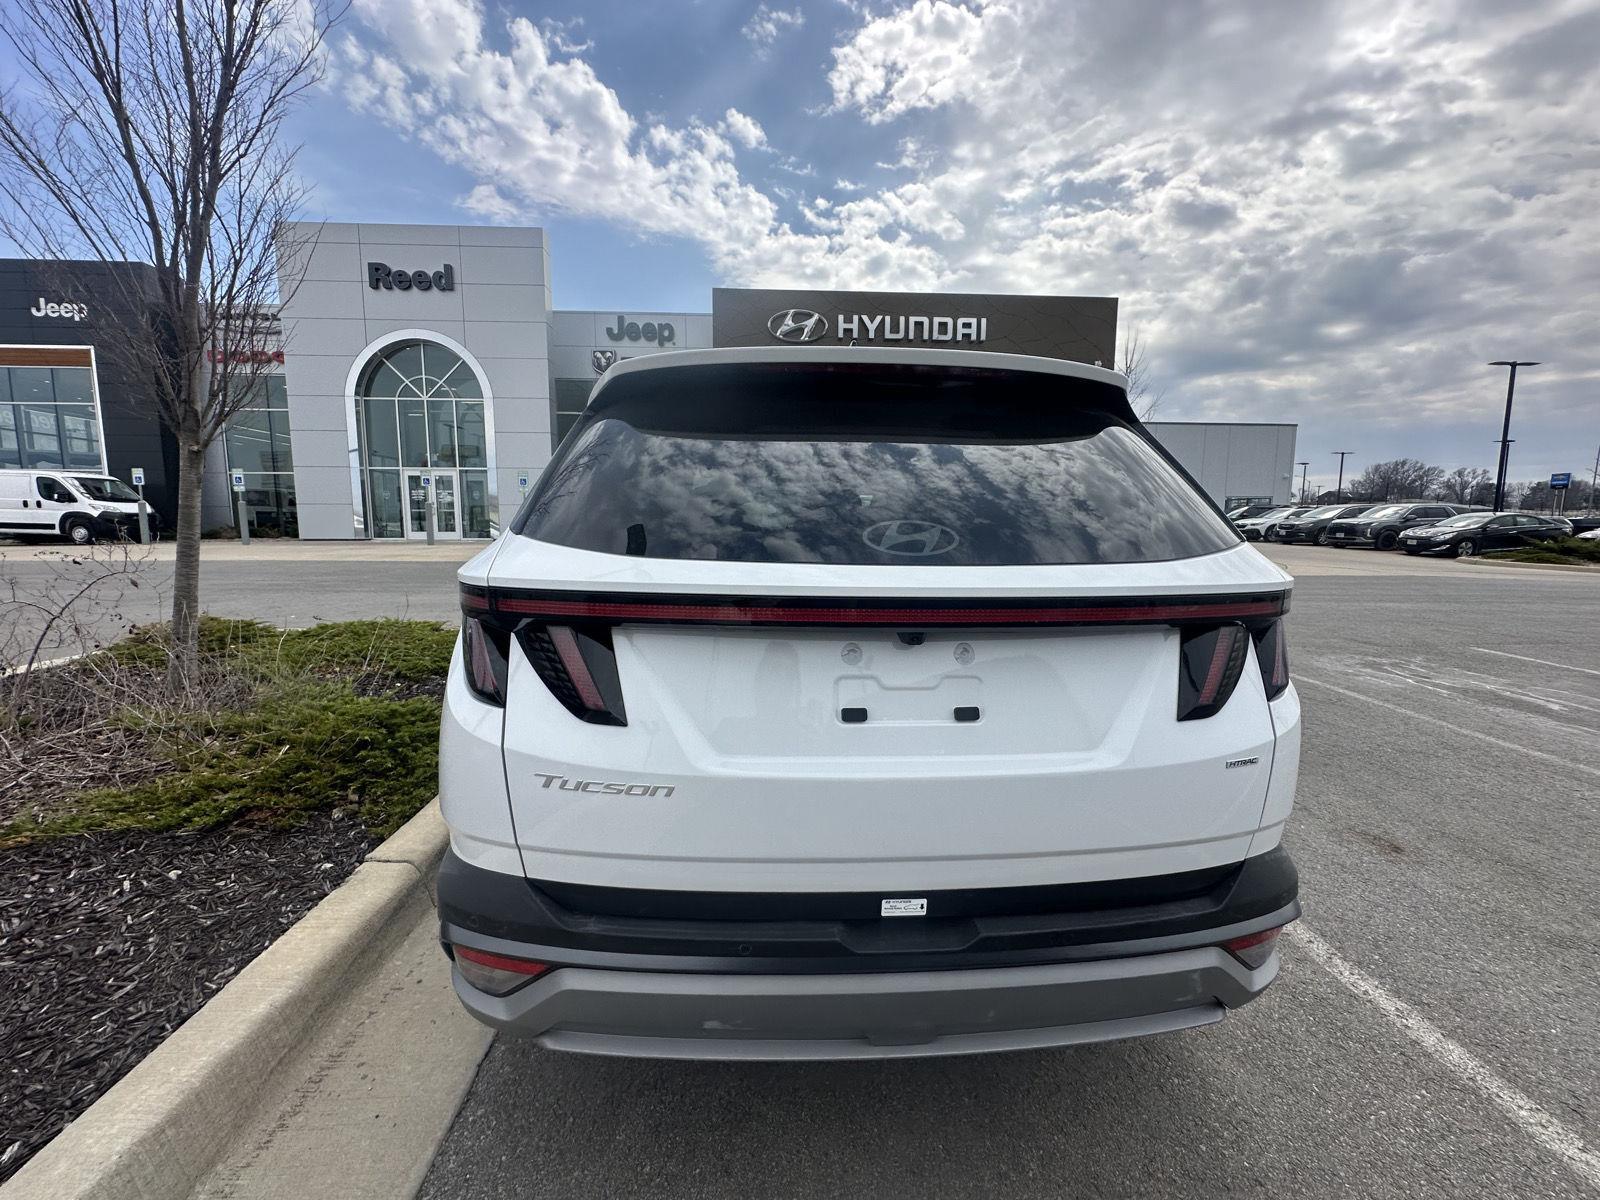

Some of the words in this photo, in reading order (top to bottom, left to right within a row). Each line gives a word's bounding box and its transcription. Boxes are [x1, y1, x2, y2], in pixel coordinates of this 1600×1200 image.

[367, 262, 455, 291] Reed
[30, 297, 88, 322] Jeep
[605, 315, 675, 347] Jeep
[837, 313, 988, 341] HYUNDAI
[1227, 757, 1258, 769] HTRAC
